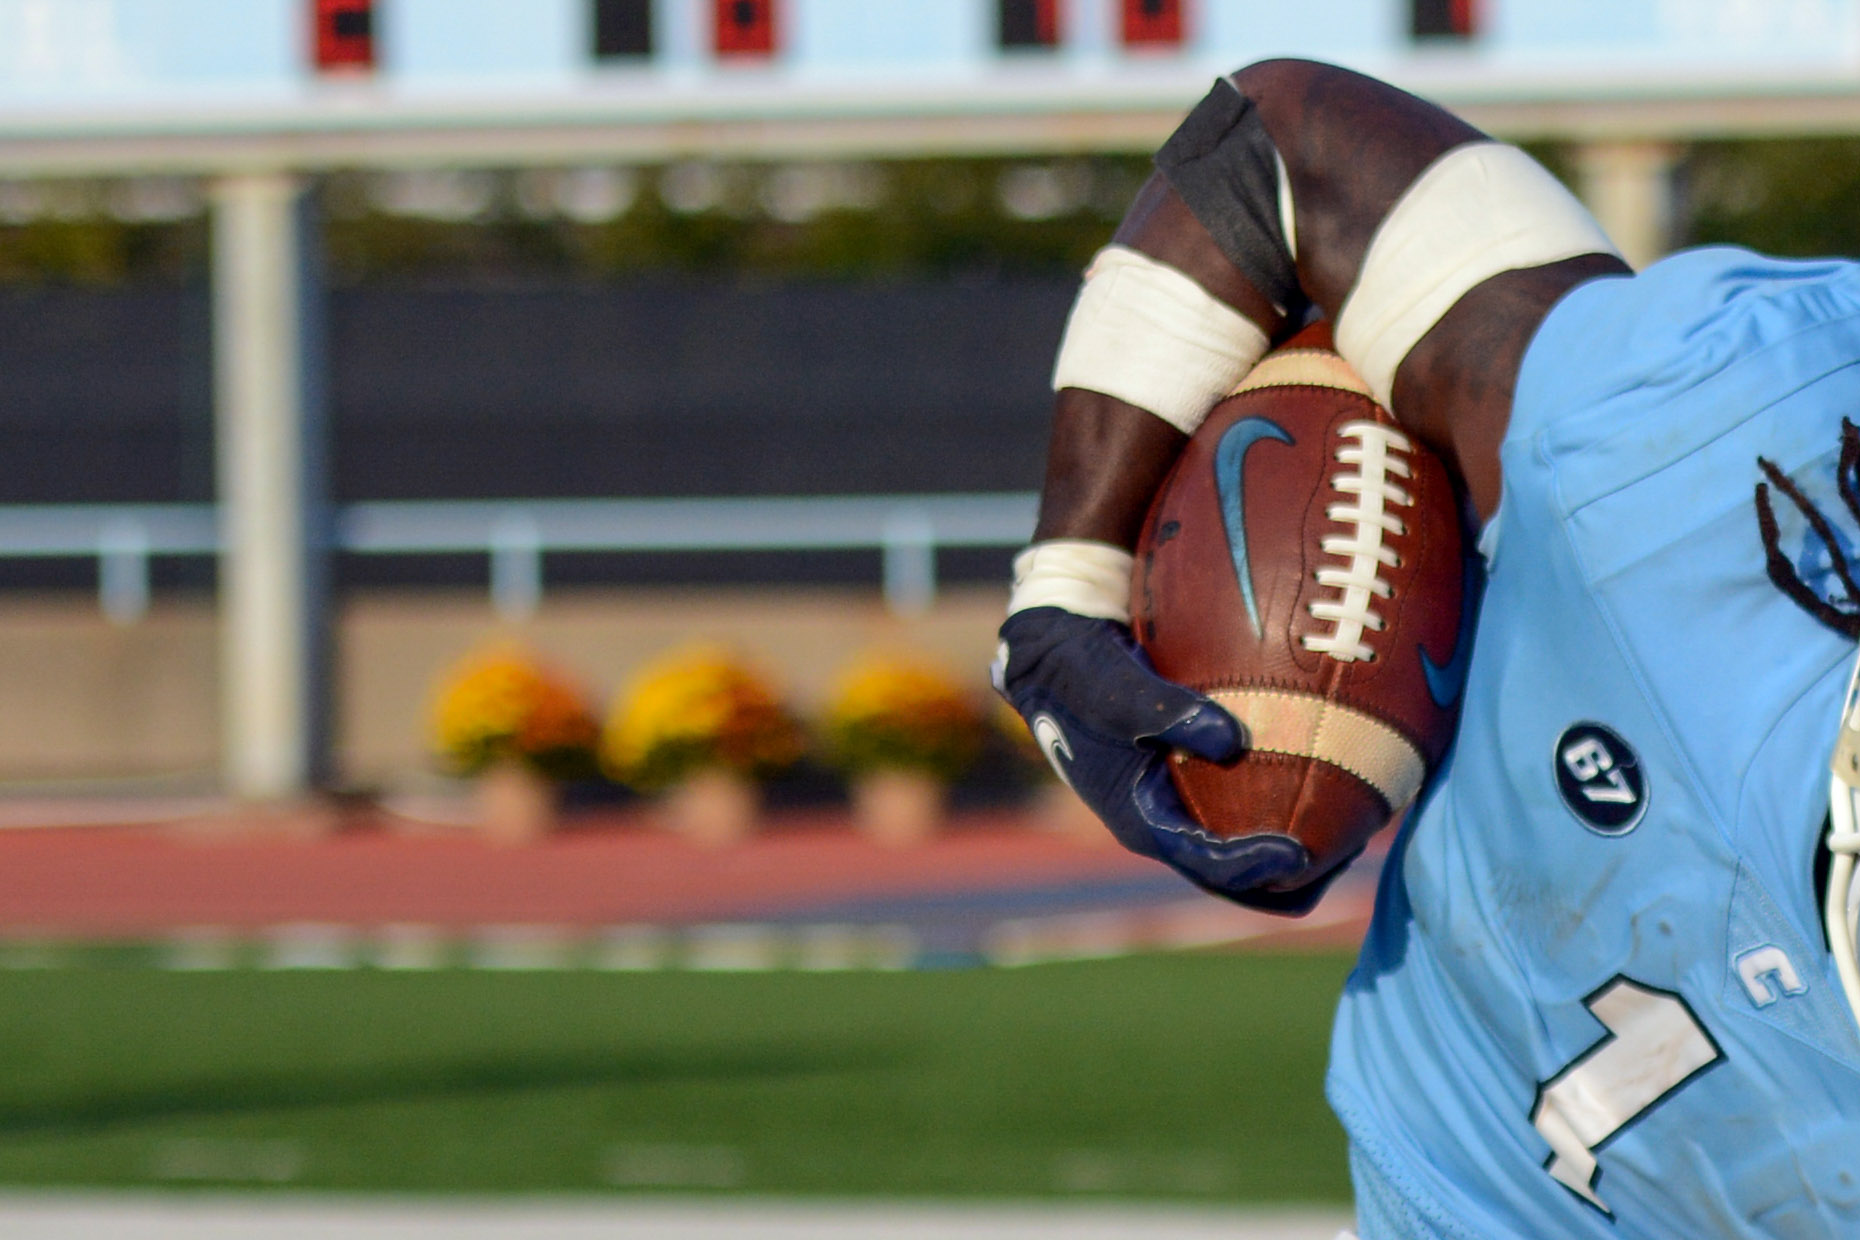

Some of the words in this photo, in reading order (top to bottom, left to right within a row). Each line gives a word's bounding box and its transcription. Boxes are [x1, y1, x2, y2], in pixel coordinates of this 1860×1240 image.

[1564, 738, 1637, 805] 67
[1734, 943, 1809, 1010] C
[1528, 972, 1729, 1224] 1
